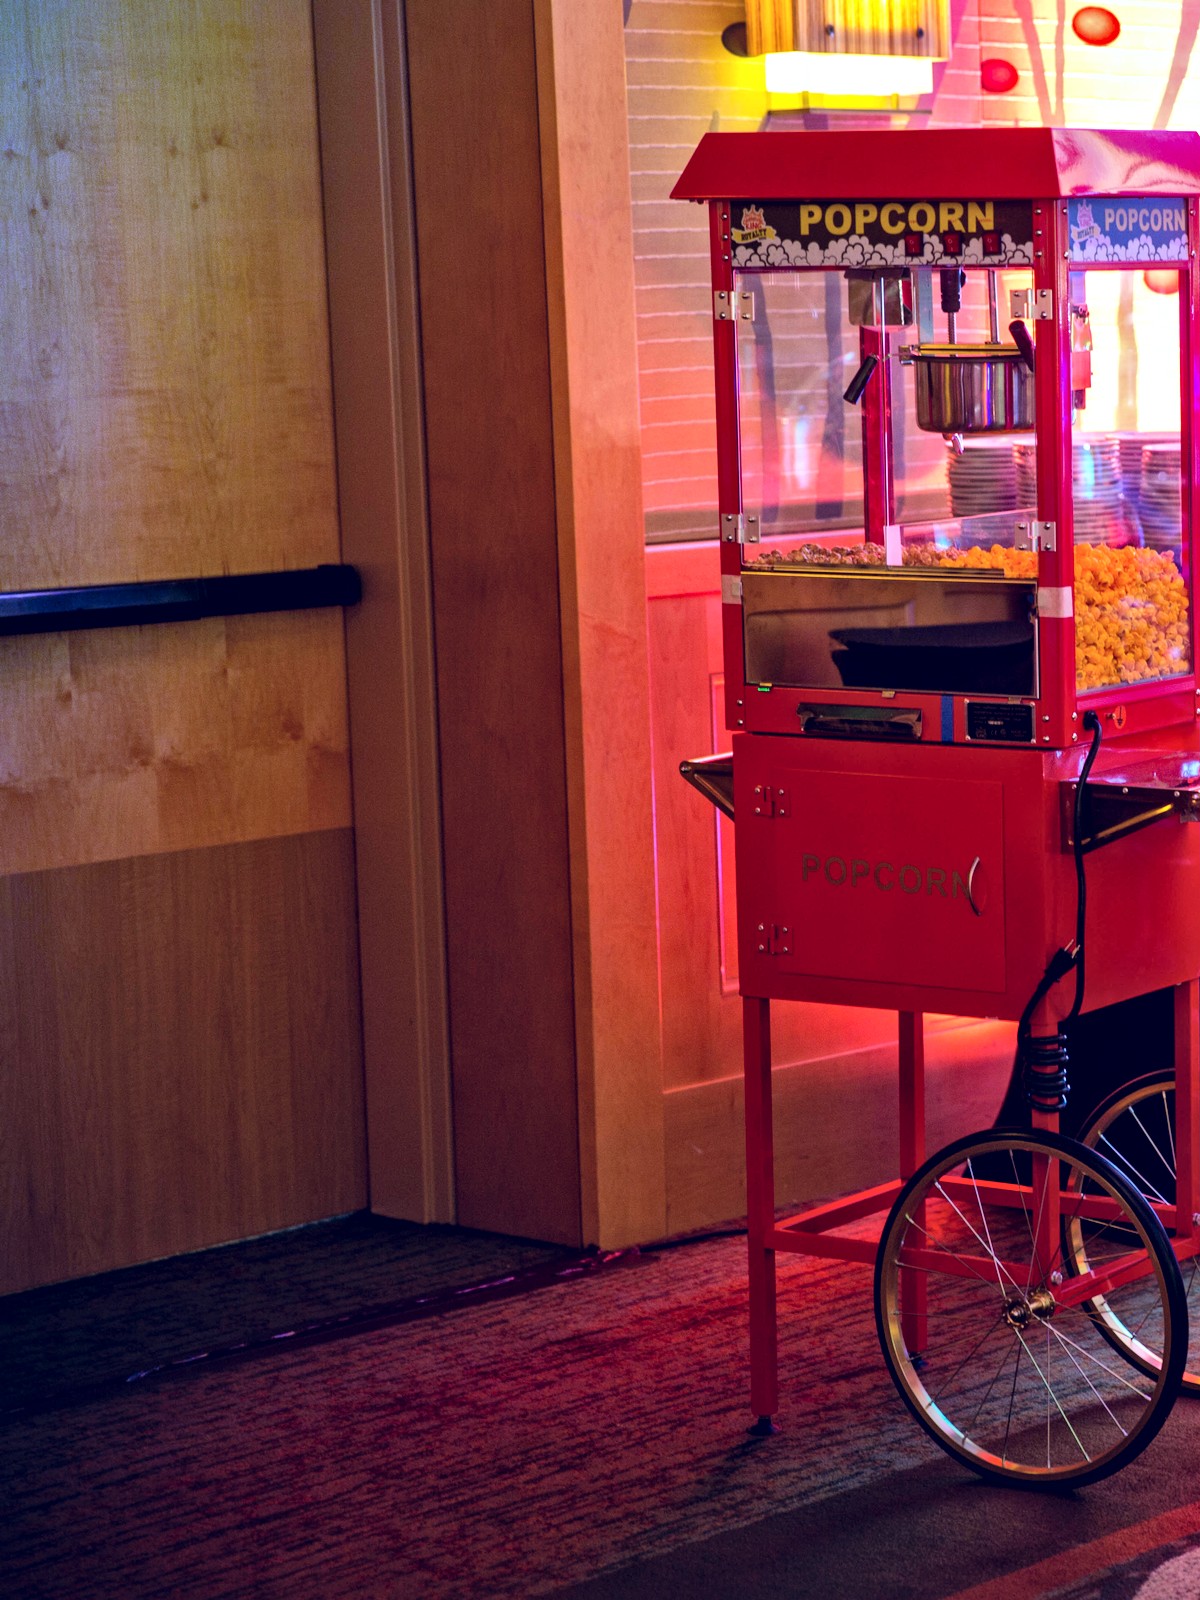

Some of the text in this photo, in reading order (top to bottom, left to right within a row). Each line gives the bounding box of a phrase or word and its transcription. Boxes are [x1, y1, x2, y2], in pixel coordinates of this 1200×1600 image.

[800, 202, 995, 236] POPCORN
[1104, 208, 1186, 232] POPCORN
[802, 854, 973, 900] POPCORN
